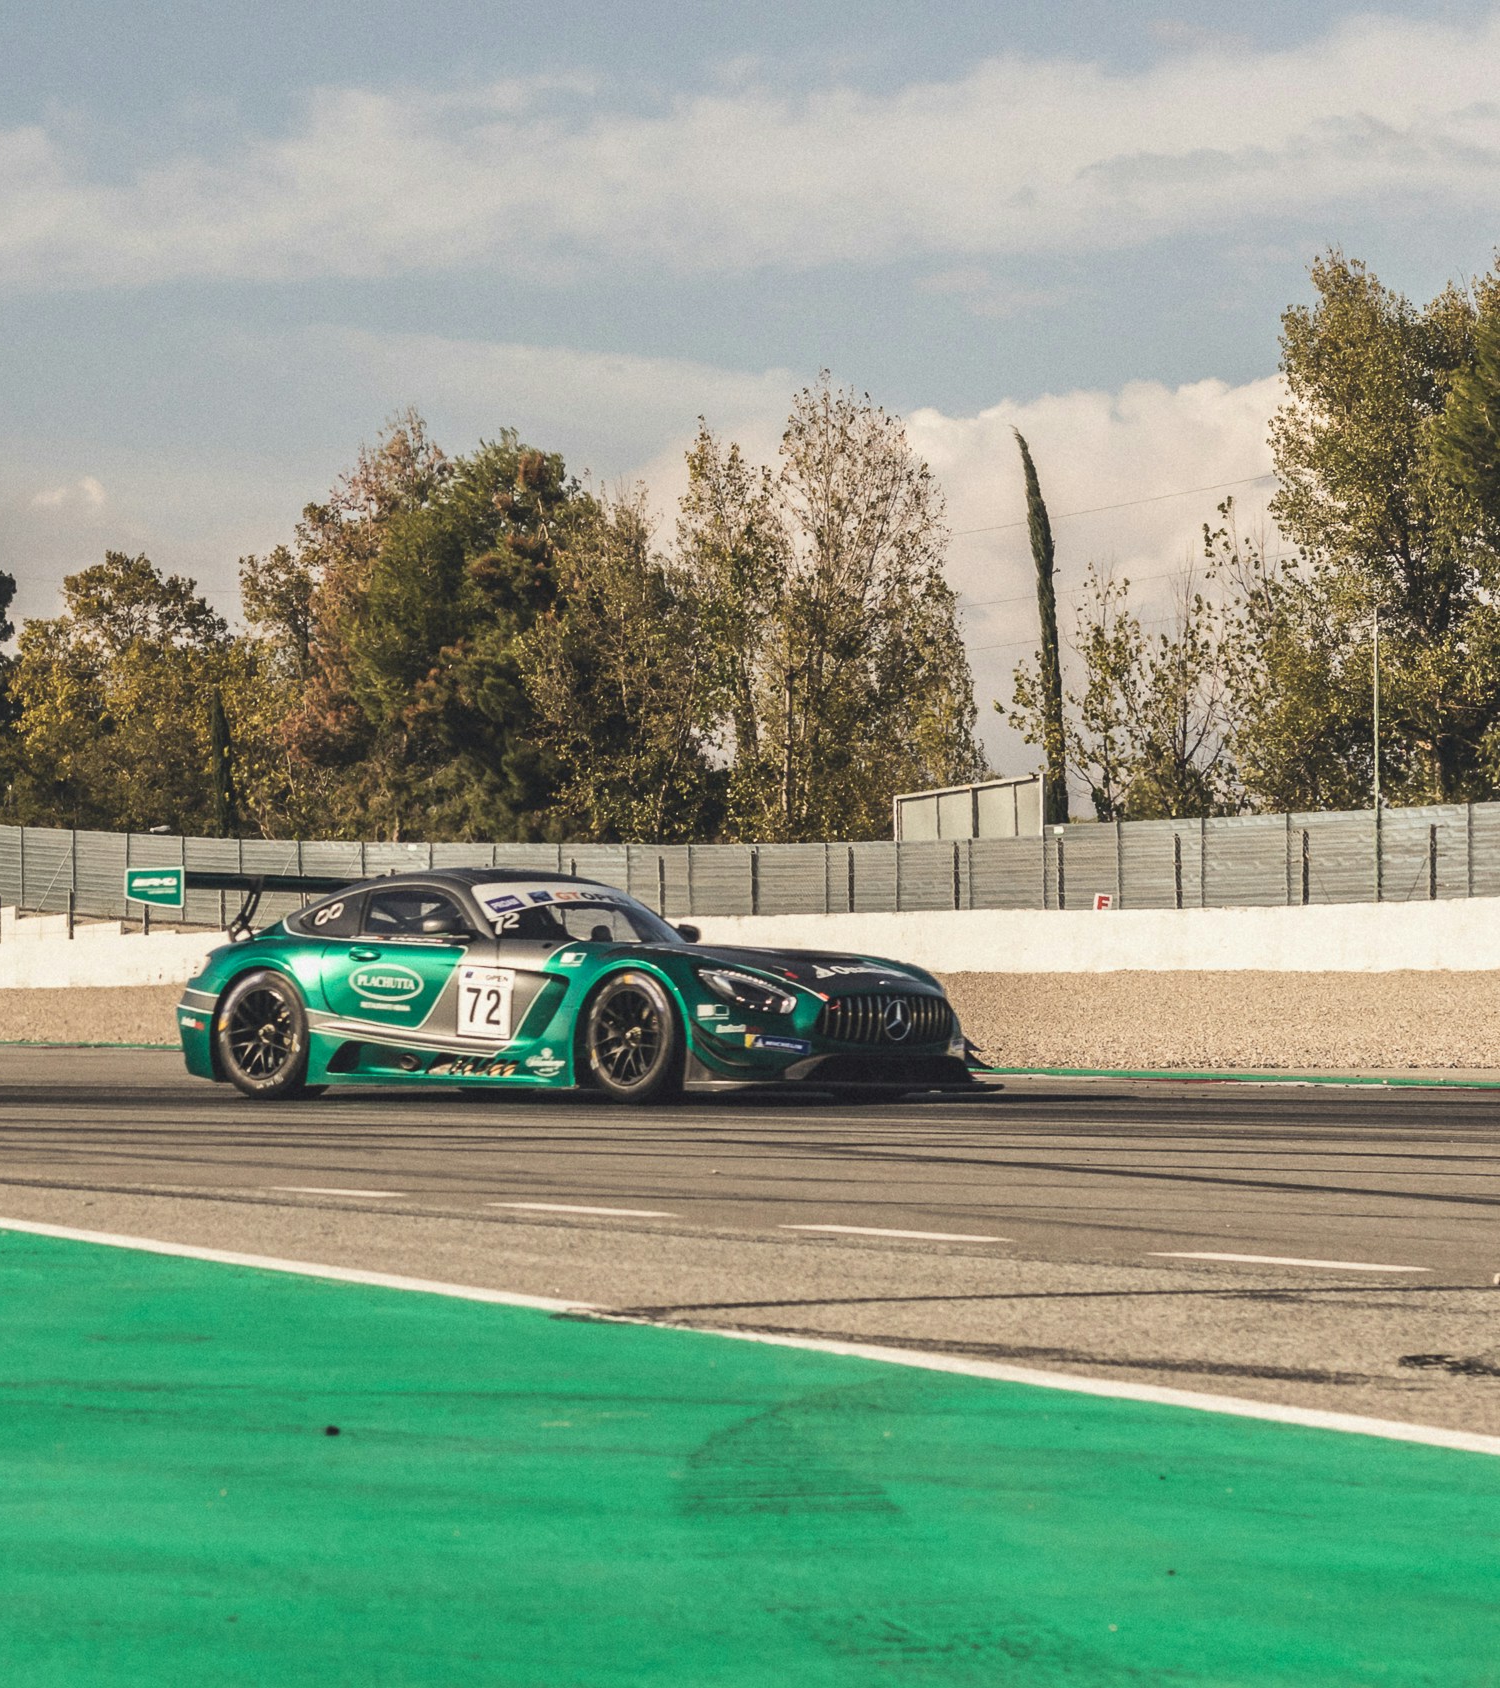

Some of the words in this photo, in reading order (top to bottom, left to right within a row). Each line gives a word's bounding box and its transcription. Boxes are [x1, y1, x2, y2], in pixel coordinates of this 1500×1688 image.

[1097, 896, 1110, 910] F
[491, 912, 520, 935] 72
[357, 974, 416, 990] PLACHUTTA
[467, 987, 501, 1025] 72
